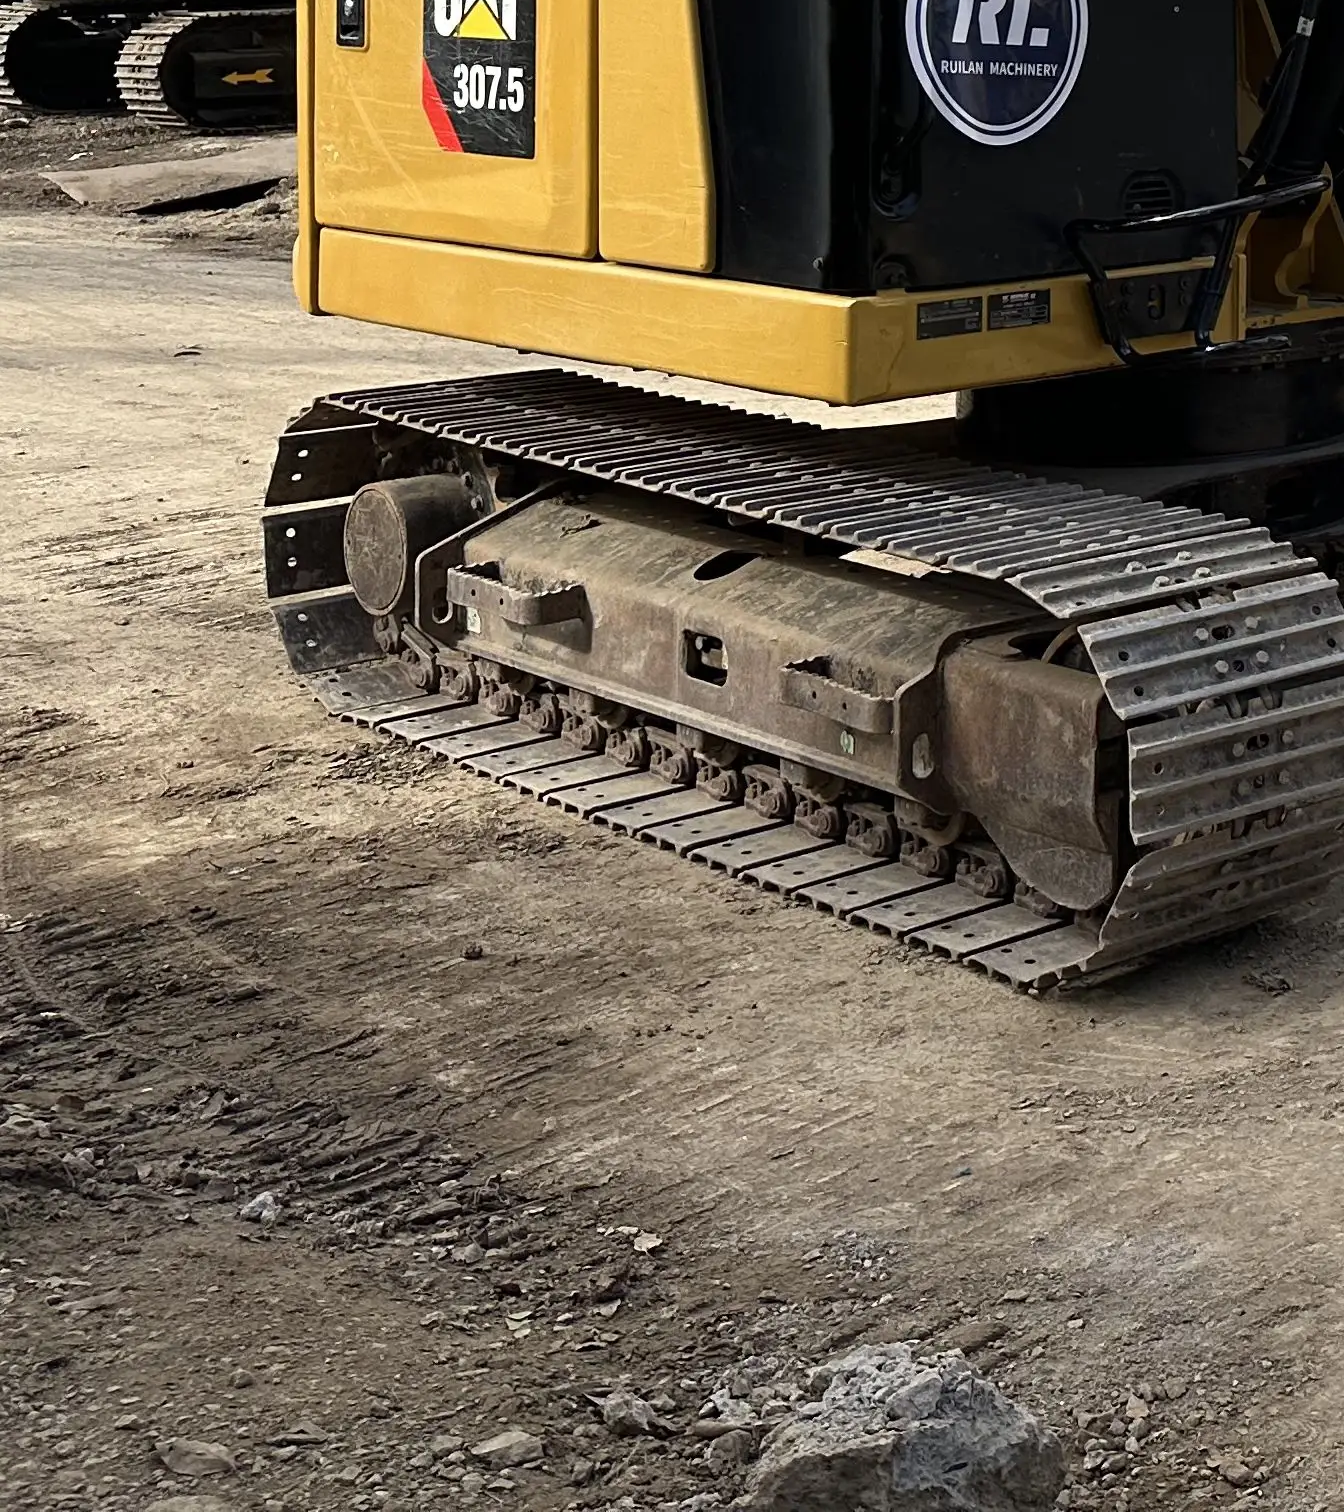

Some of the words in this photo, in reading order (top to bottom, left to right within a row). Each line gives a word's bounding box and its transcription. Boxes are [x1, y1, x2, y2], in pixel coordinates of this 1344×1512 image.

[940, 59, 984, 75] RUILAN
[989, 61, 1059, 77] MACHINERY
[453, 63, 525, 113] 307.5
